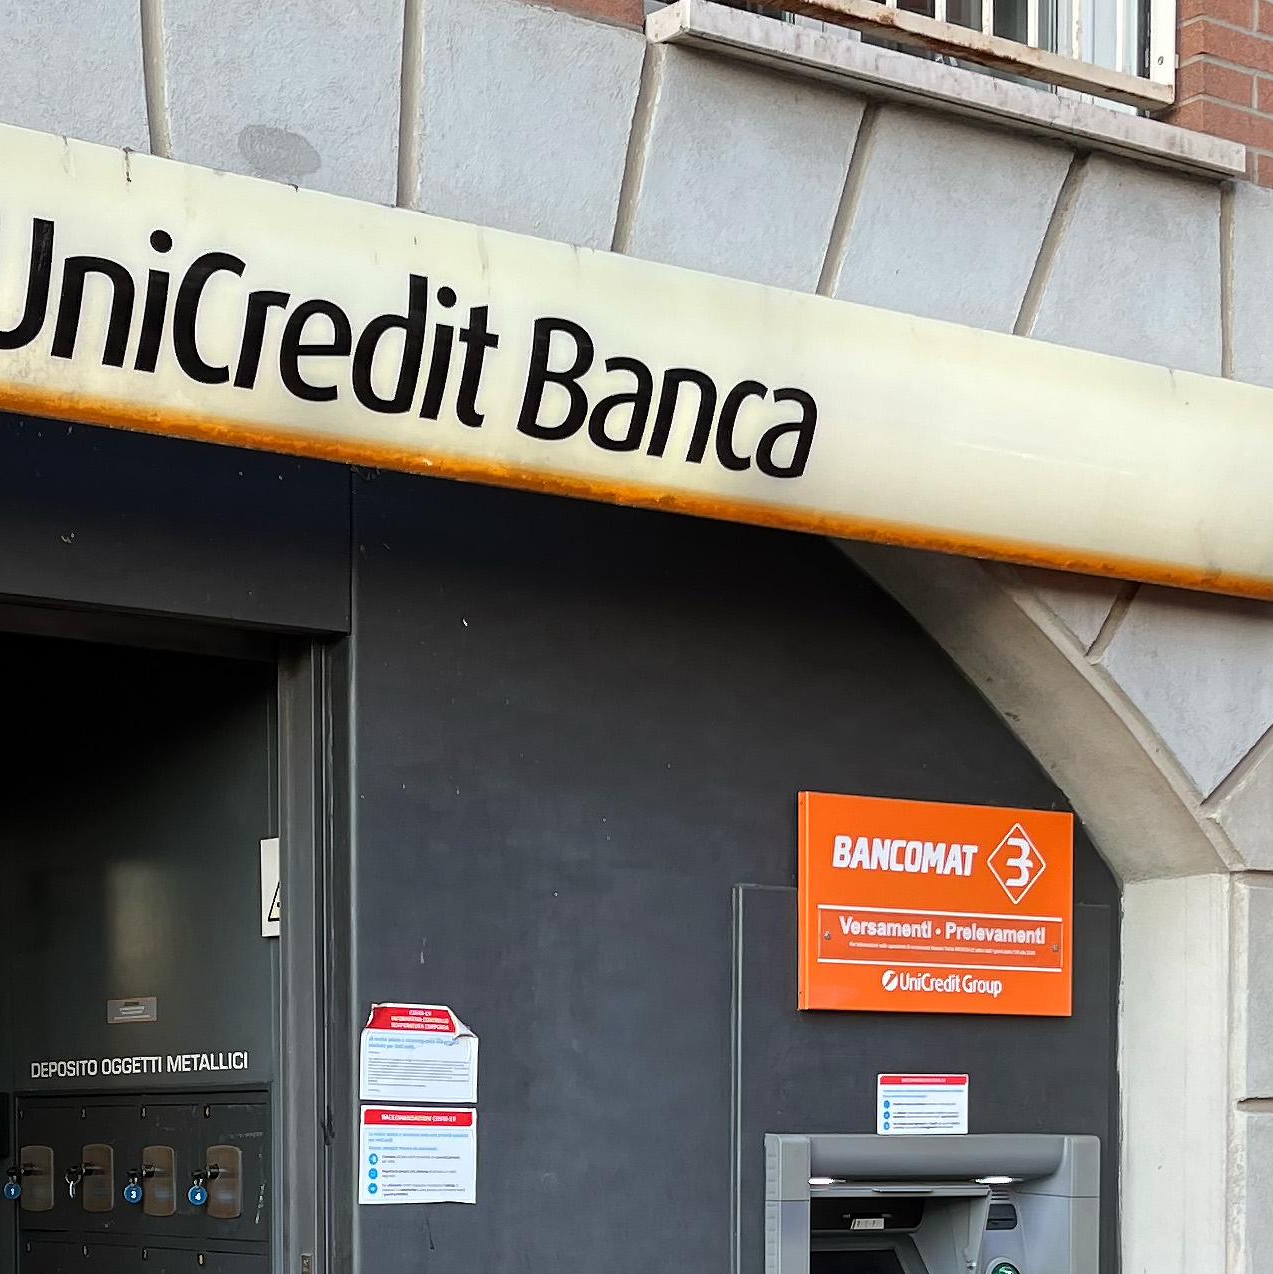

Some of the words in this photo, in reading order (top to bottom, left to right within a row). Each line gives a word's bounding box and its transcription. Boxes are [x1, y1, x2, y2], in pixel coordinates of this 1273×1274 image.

[516, 315, 819, 480] Banca
[832, 834, 979, 877] BANCOMAT
[838, 915, 932, 939] Versamenti
[944, 921, 1046, 945] Prelevamenti
[898, 972, 961, 993] UniCredit
[962, 974, 1003, 998] Group
[30, 1059, 99, 1079] DEPOSITO
[101, 1055, 163, 1076] OGGETTI
[165, 1051, 249, 1073] METALLICI
